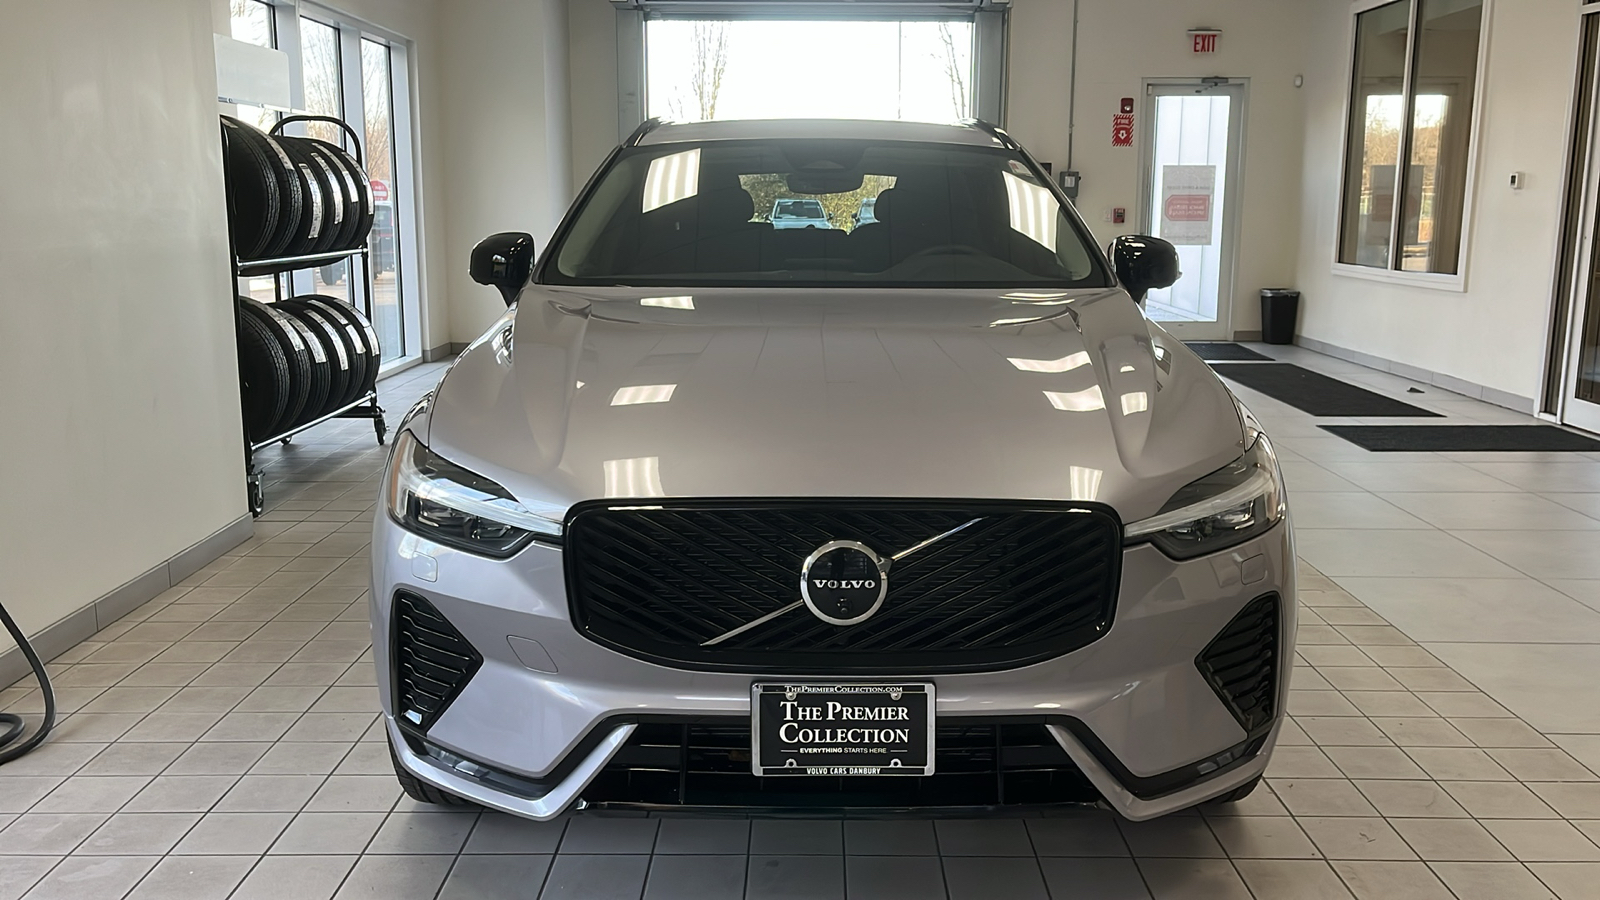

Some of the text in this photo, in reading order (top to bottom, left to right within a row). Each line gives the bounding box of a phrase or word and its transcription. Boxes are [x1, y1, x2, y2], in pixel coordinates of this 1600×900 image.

[1194, 34, 1217, 52] EXIT
[813, 580, 875, 588] VOLVO
[780, 701, 909, 721] THE PREMIER
[779, 722, 909, 744] COLLECTION
[807, 767, 880, 775] VOLVO CARS DANBURY
